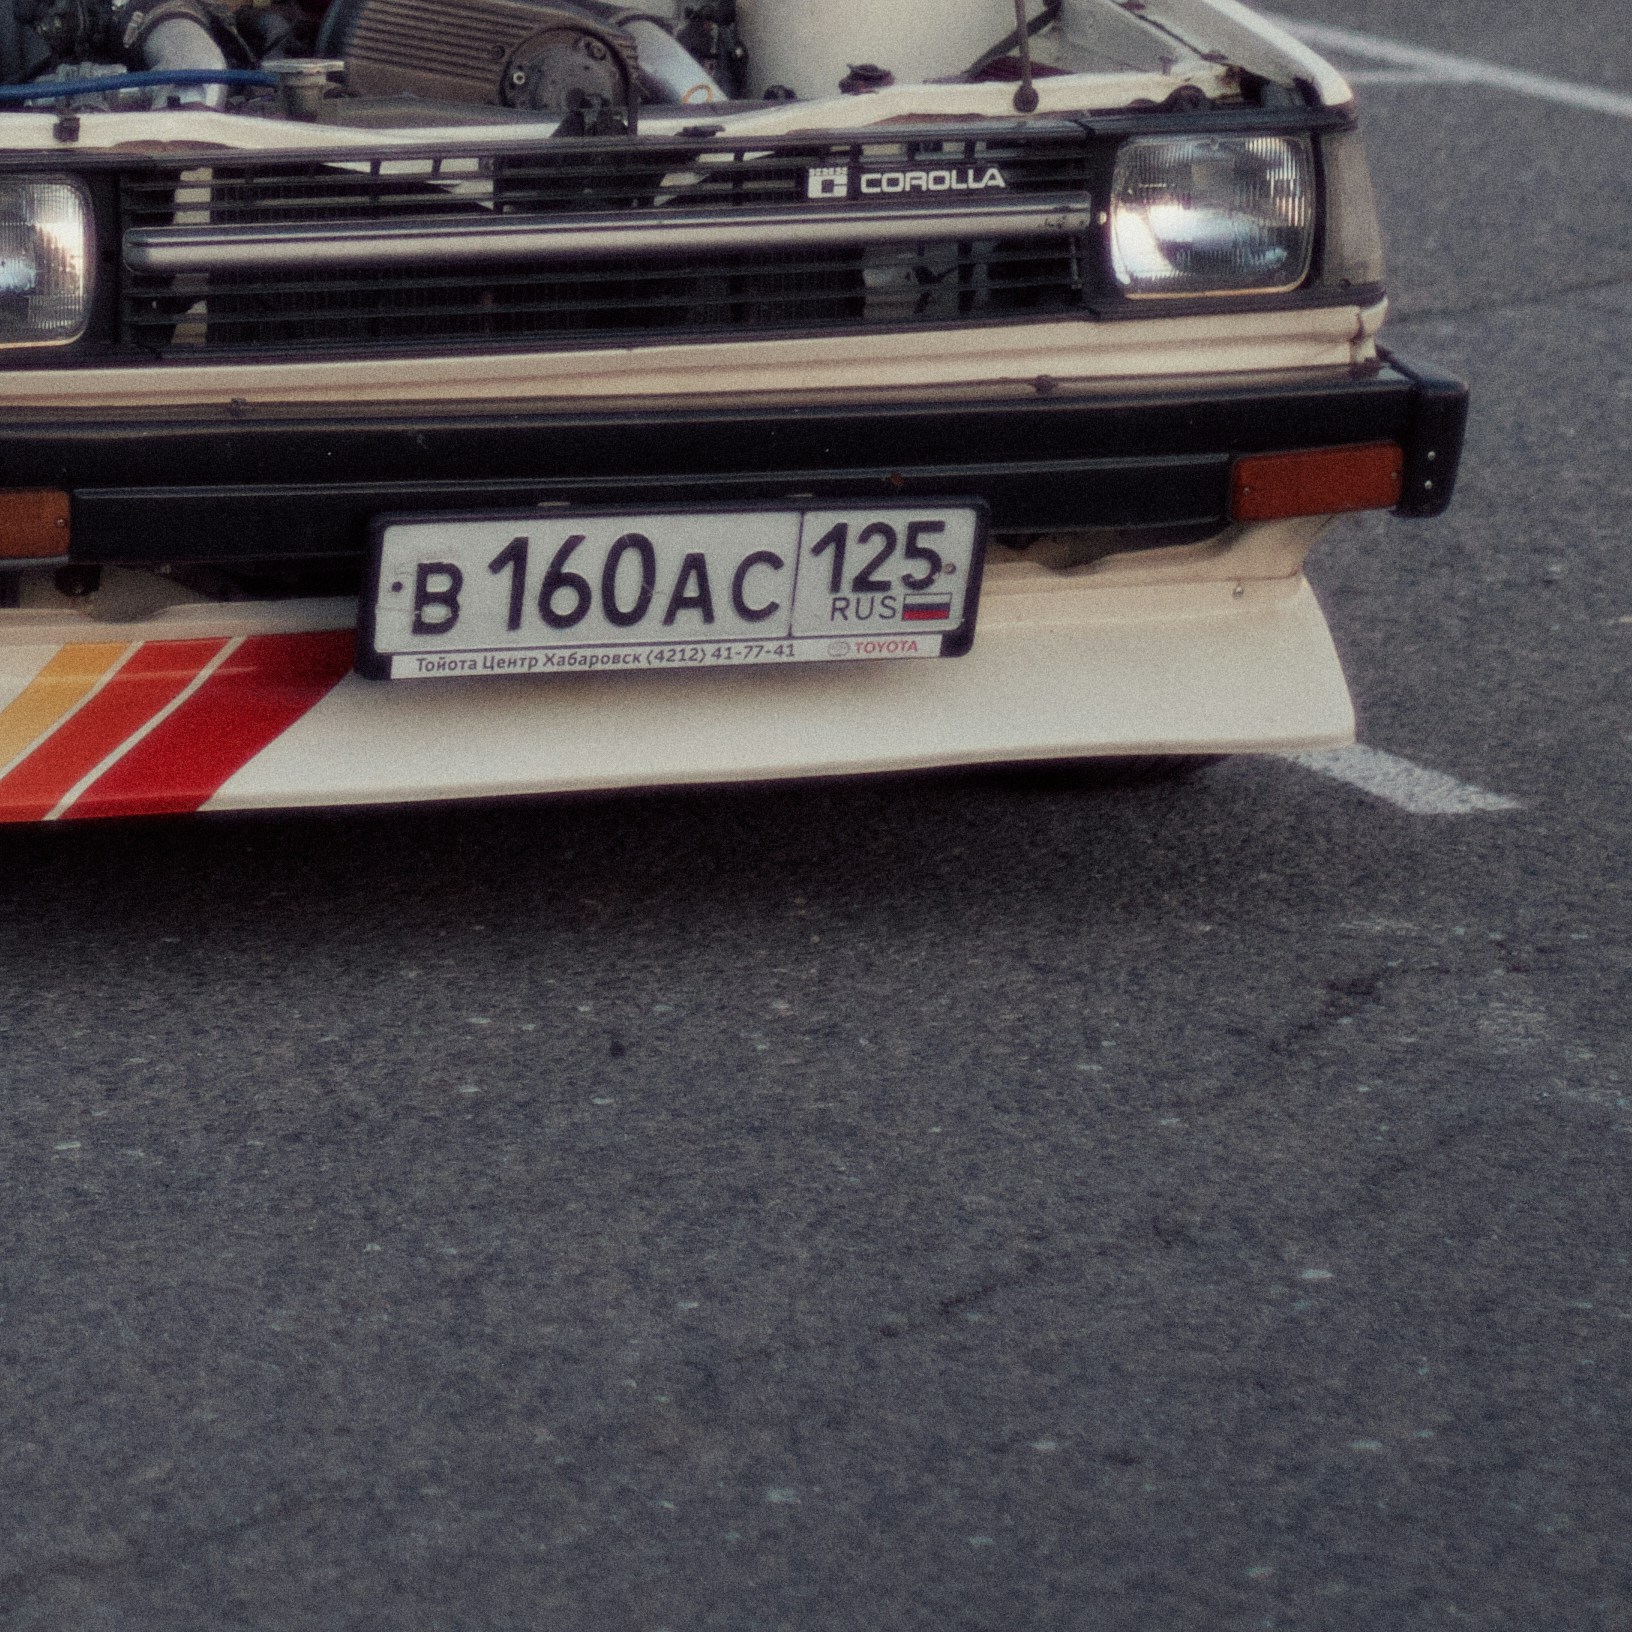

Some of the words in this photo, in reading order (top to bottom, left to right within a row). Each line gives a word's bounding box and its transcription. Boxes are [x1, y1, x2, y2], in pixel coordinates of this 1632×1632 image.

[860, 168, 1006, 193] COROLLA
[810, 520, 946, 594] 125
[830, 595, 898, 622] RUS
[416, 654, 478, 673] Тойота
[482, 652, 538, 674] Центр
[542, 646, 642, 670] Хабаровск
[646, 644, 707, 666] (4212)
[712, 640, 796, 662] 41-77-41
[854, 638, 919, 654] TOYOTA
